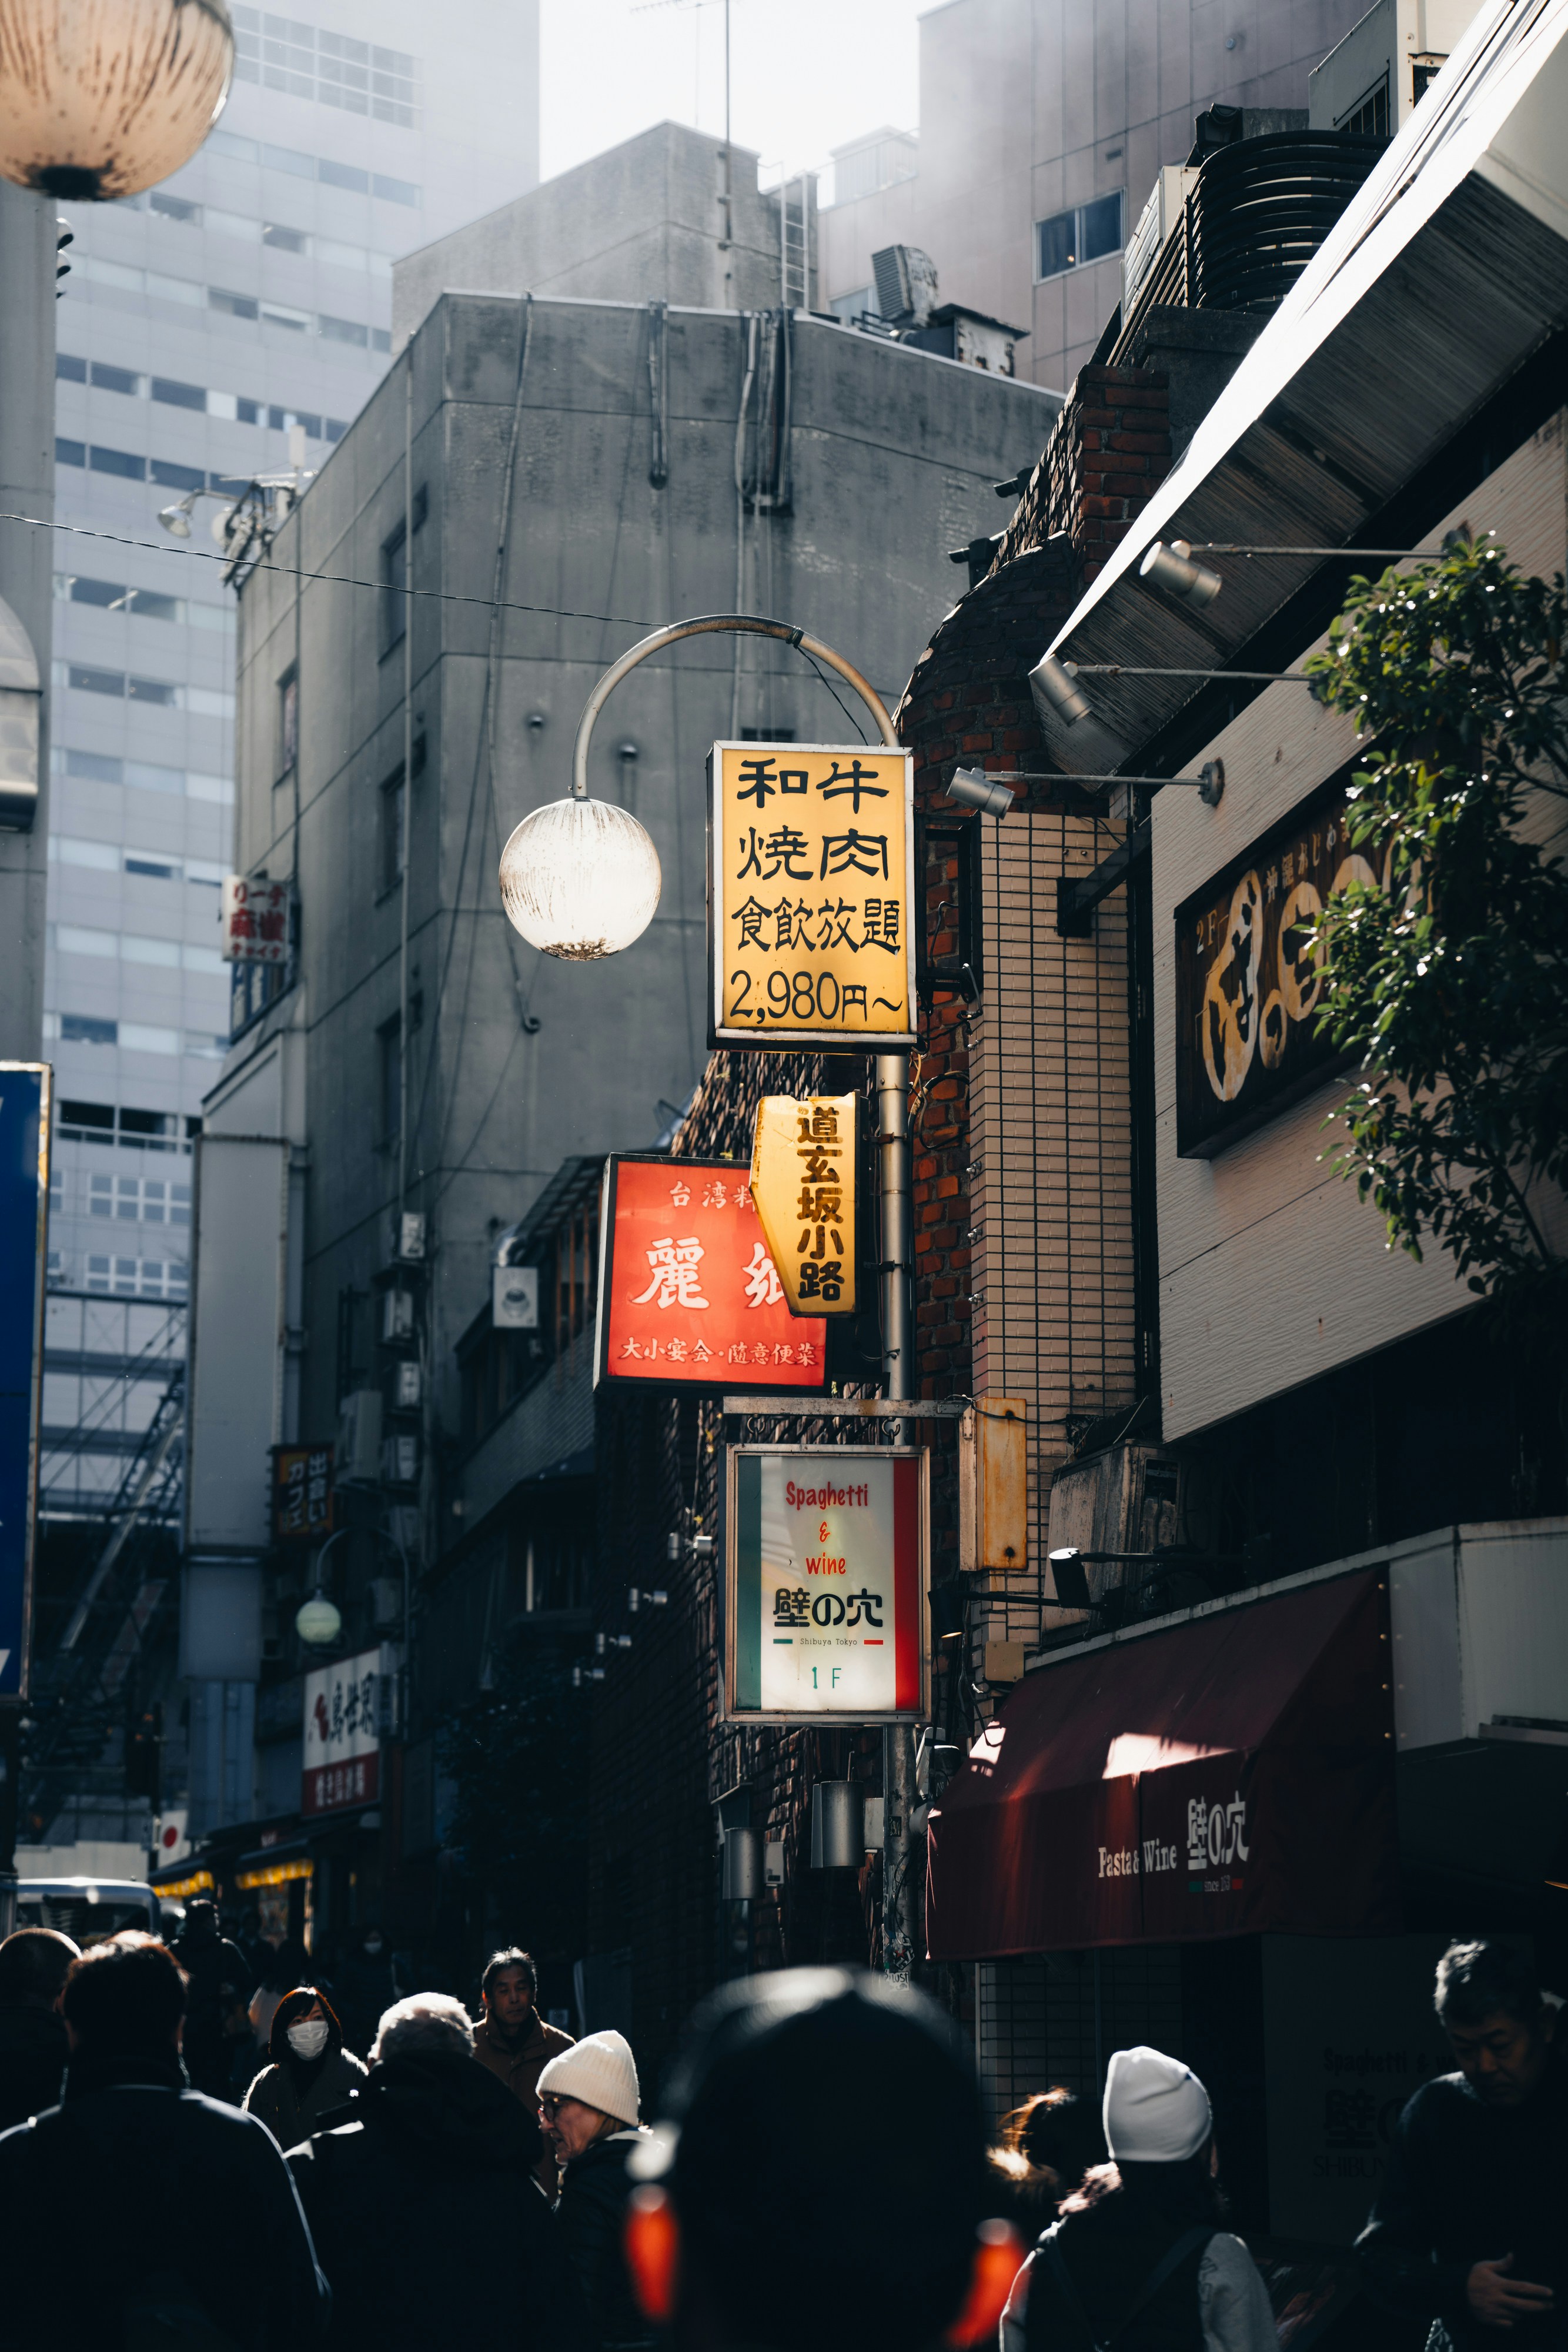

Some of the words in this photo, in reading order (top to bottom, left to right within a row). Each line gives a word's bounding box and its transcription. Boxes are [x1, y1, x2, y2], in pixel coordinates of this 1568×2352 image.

[737, 758, 890, 814] 和牛
[737, 825, 888, 881] 焼肉
[731, 896, 901, 956] 食飲放題
[1196, 909, 1218, 956] 2F
[797, 1106, 844, 1302] 道玄坂小路
[785, 1481, 868, 1511] Spaghetti
[819, 1521, 831, 1543] &
[806, 1552, 847, 1575] wine
[773, 1587, 883, 1628] 壁の穴
[800, 1638, 832, 1647] Shibuya
[835, 1638, 858, 1647] Tokyo
[1186, 1790, 1249, 1870] 壁の穴
[1143, 1838, 1177, 1873] Wine
[1323, 2047, 1407, 2076] Spaghetti
